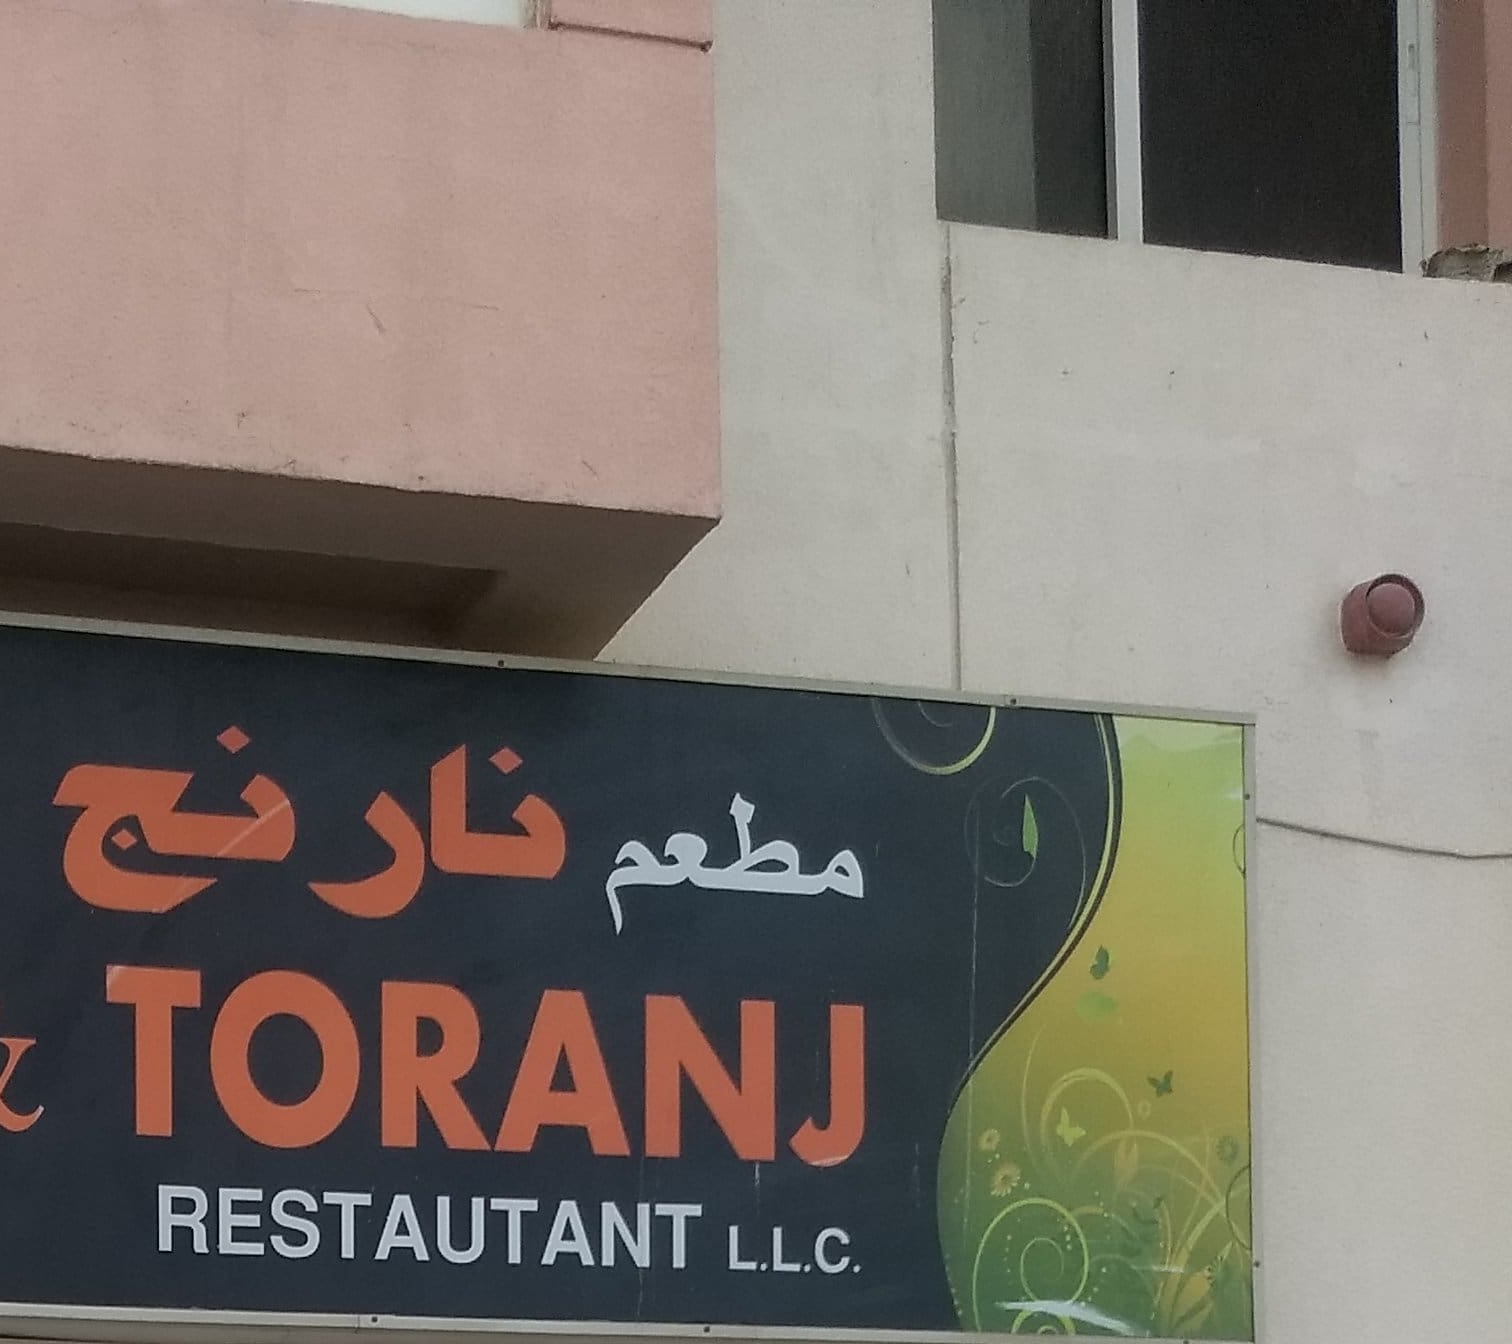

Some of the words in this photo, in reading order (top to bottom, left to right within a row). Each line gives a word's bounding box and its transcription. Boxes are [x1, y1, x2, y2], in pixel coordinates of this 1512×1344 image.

[52, 725, 567, 919] نارنج
[604, 791, 865, 936] مطعم
[106, 964, 866, 1167] TORANJ
[156, 1184, 703, 1269] RESTAUTANT
[728, 1225, 862, 1274] L.L.C.
